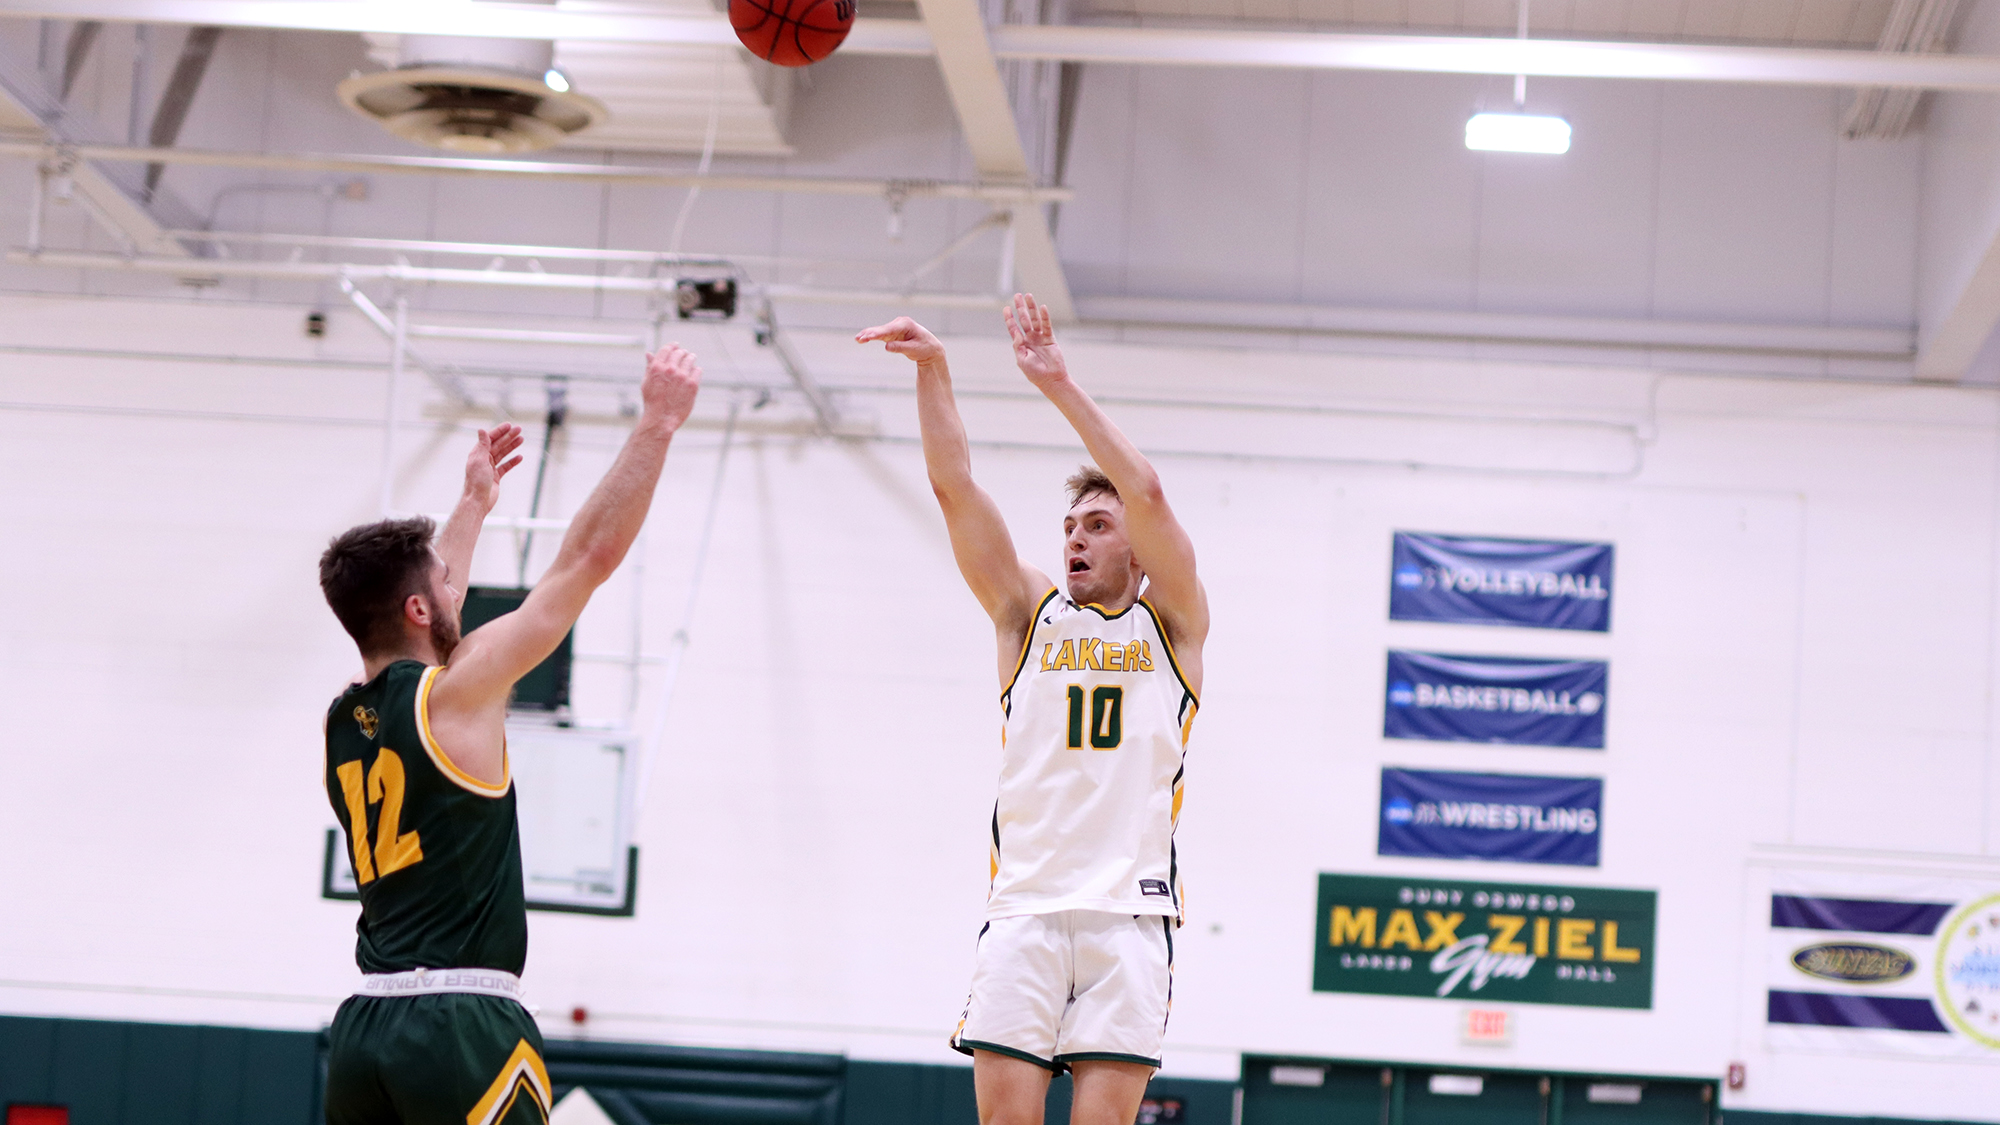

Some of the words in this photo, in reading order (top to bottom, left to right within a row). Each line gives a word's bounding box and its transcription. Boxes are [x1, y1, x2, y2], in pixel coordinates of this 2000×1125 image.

[1440, 567, 1608, 599] VOLLEYBALL
[1040, 637, 1155, 673] LAKERS
[1066, 683, 1124, 751] 10
[1415, 682, 1577, 715] BASKETBALL
[336, 747, 423, 885] 12
[1439, 801, 1597, 834] WRESTLING
[1329, 905, 1465, 952] MAX
[1488, 914, 1641, 963] ZIEL
[1430, 934, 1536, 998] Gym
